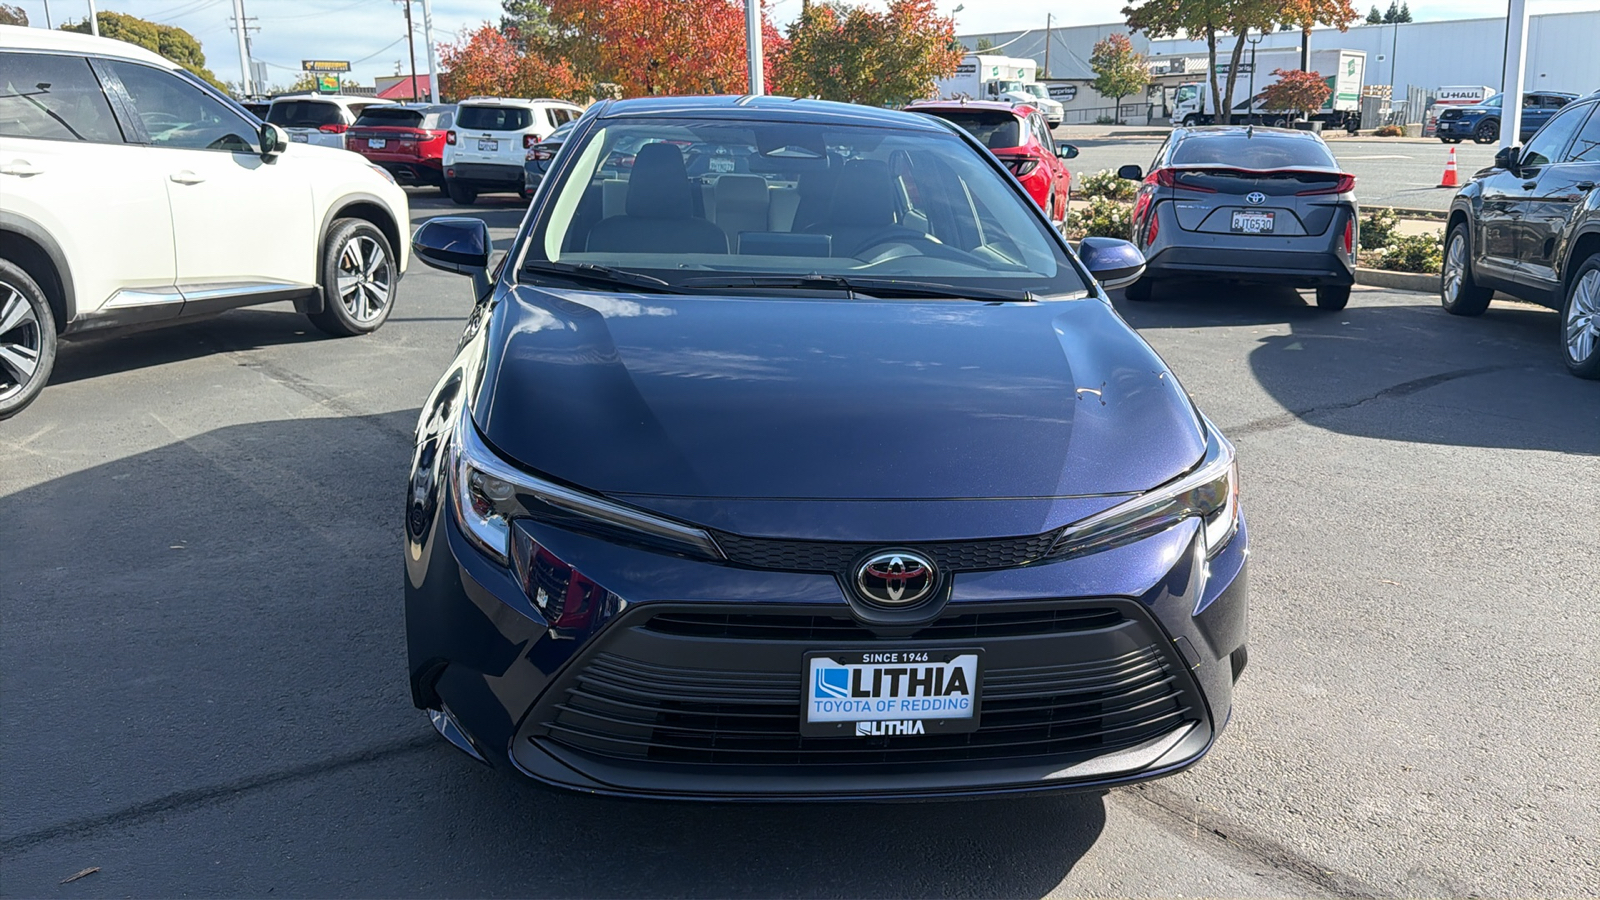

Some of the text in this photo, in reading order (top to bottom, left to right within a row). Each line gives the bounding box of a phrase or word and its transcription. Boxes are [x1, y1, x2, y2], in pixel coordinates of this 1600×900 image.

[1049, 87, 1076, 95] erprise
[1234, 218, 1272, 229] 8JTG530
[862, 652, 929, 663] SINCE 1946
[851, 666, 970, 698] LITHIA
[814, 697, 969, 713] TOYOTA OF REDDING
[871, 720, 925, 736] LITHIA
